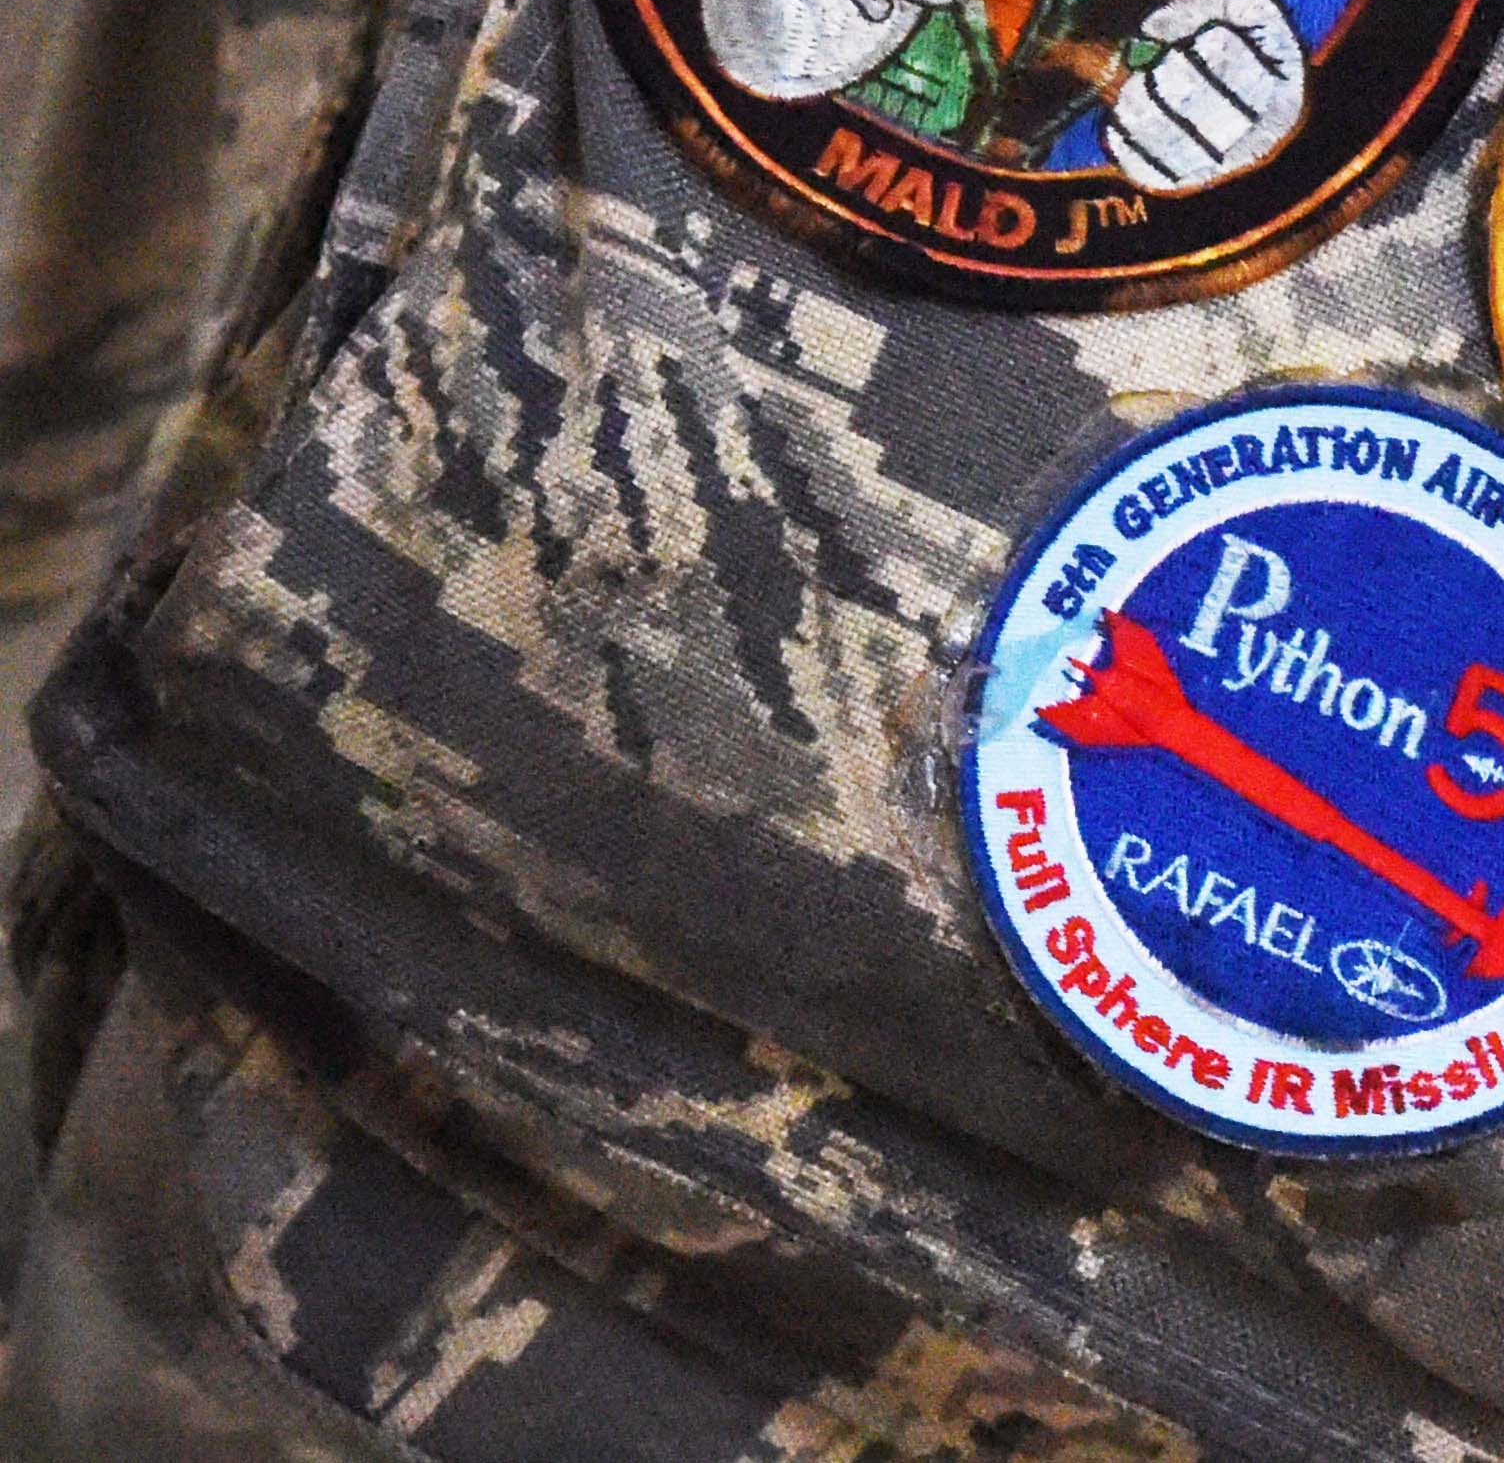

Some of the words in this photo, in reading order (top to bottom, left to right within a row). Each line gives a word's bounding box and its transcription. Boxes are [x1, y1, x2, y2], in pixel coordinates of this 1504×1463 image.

[815, 126, 1036, 248] MALD
[1042, 544, 1117, 620] 5th
[1114, 425, 1420, 540] GENERATION
[1179, 533, 1428, 760] Python
[996, 788, 1072, 913] Full
[1045, 915, 1234, 1091] Sphere
[1246, 1058, 1315, 1117] IR
[1103, 832, 1324, 975] RAFAEL
